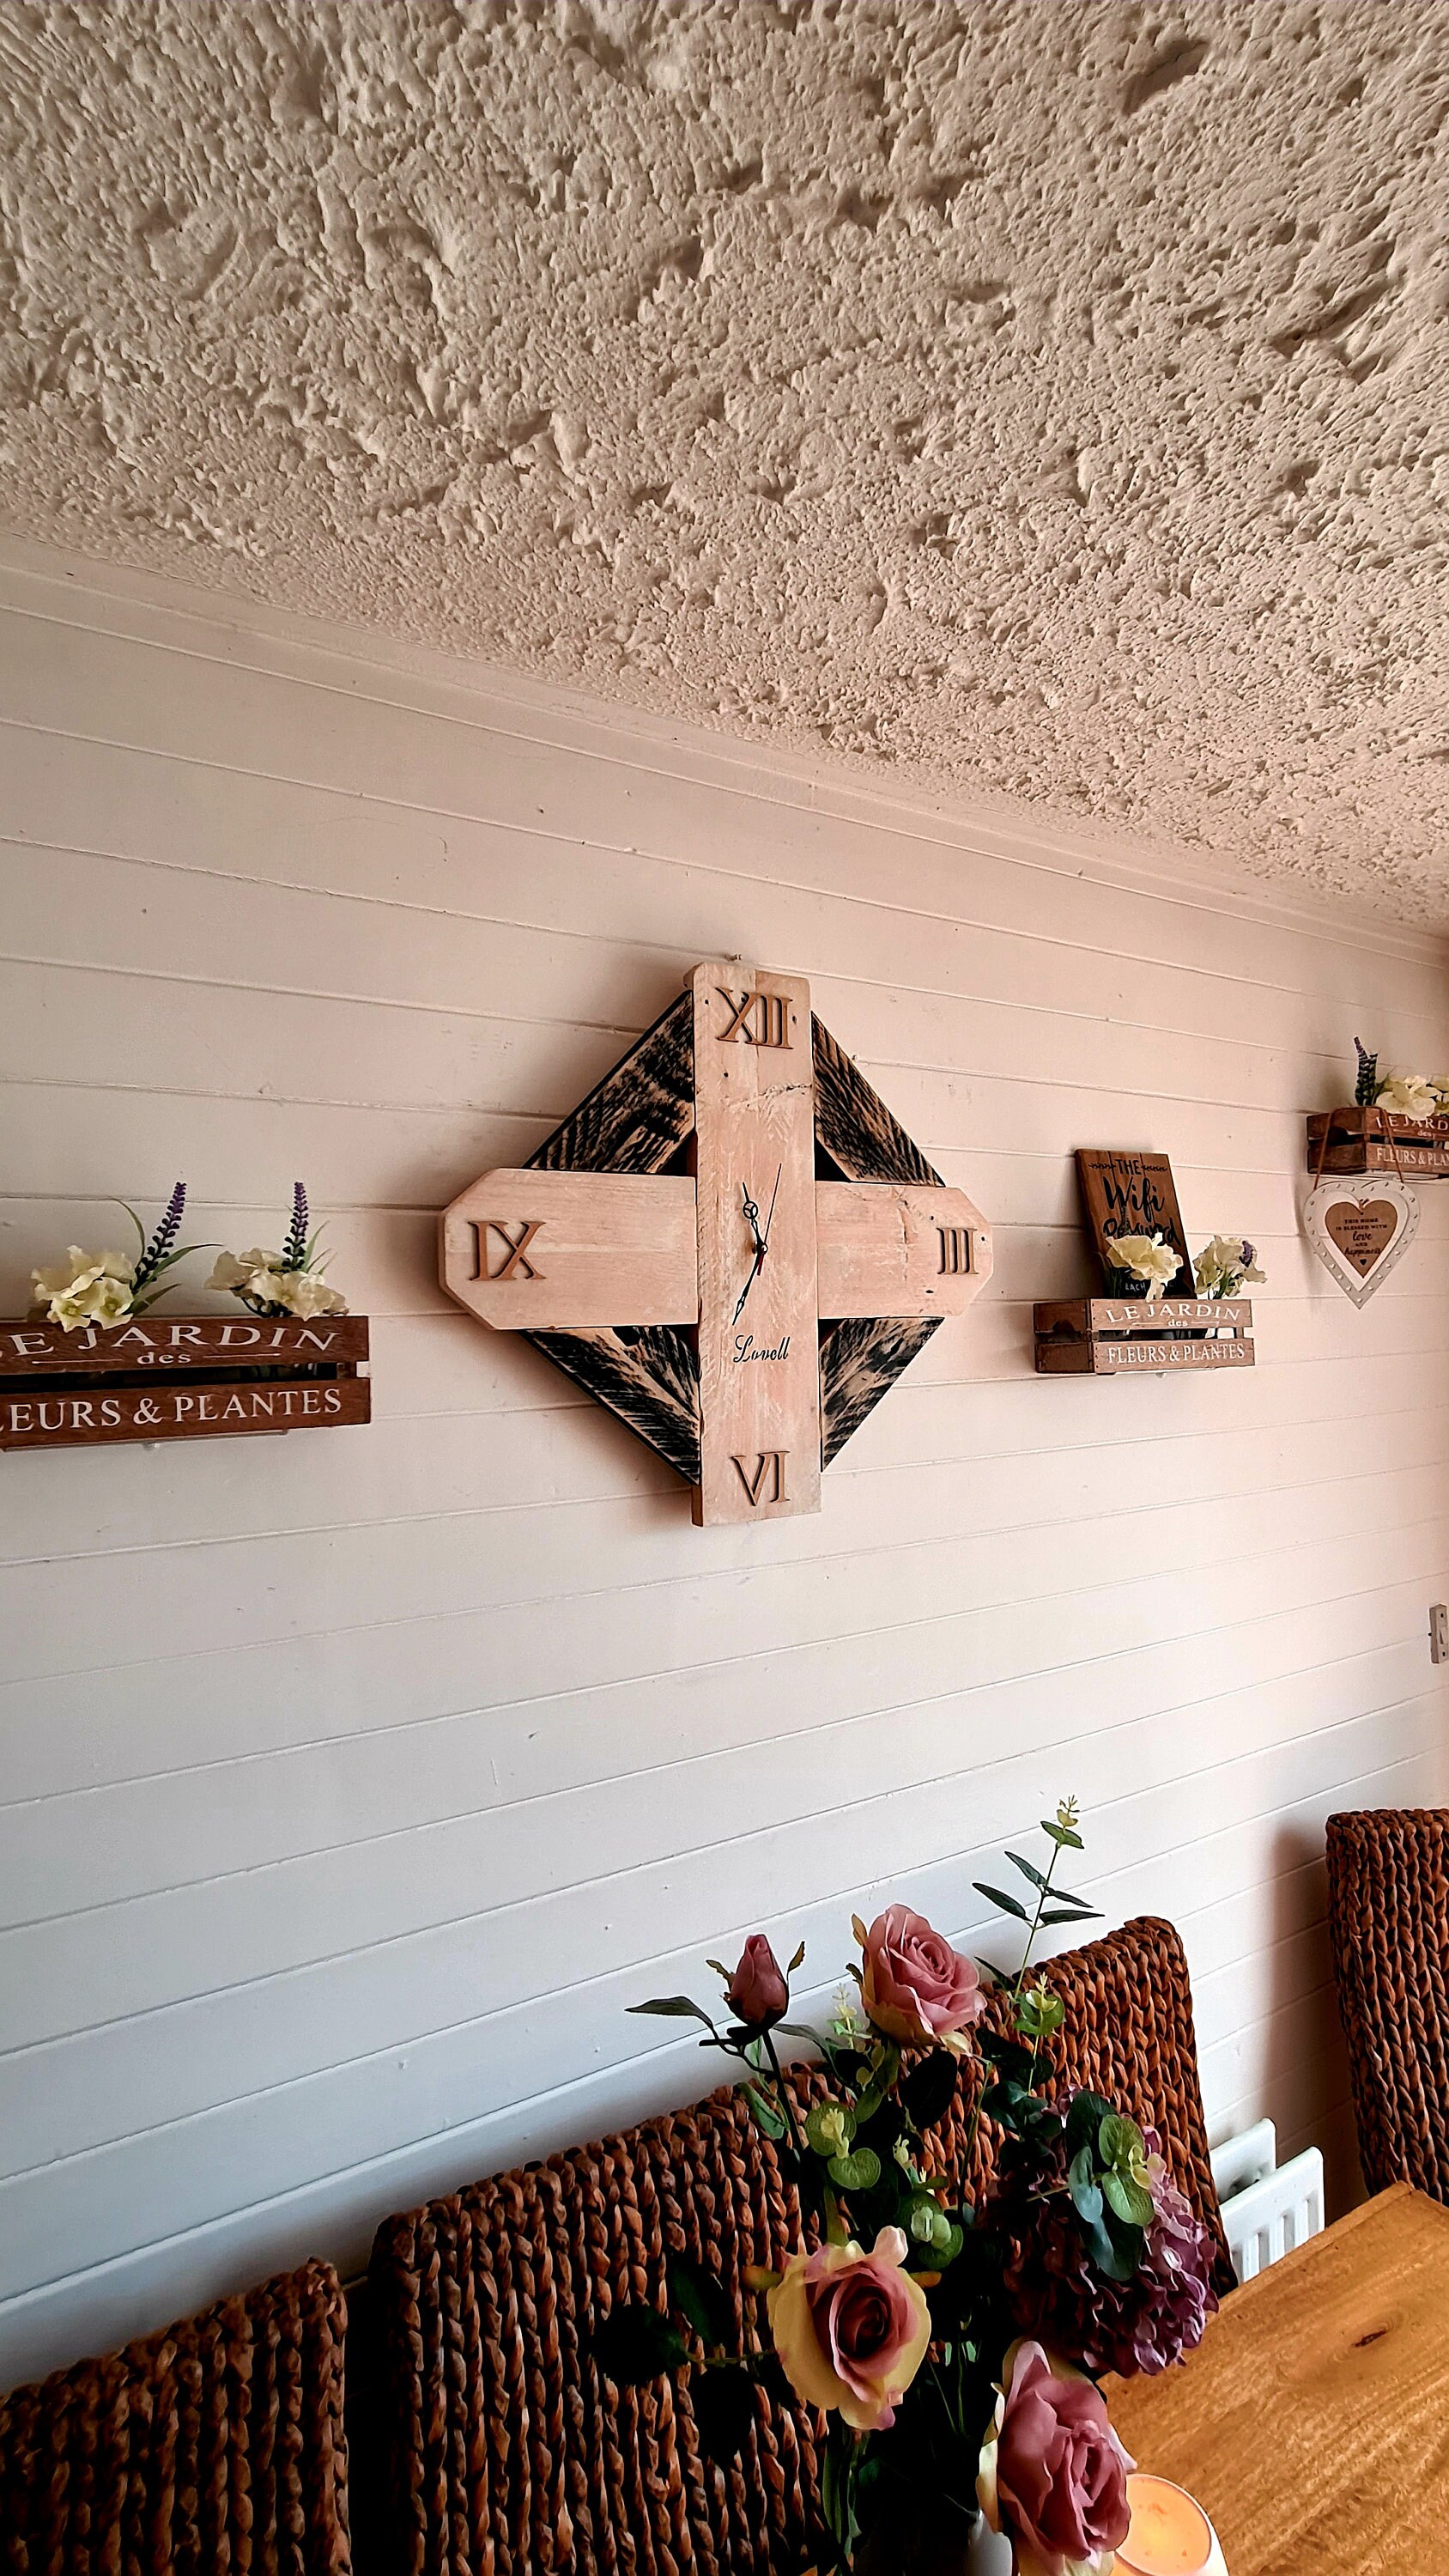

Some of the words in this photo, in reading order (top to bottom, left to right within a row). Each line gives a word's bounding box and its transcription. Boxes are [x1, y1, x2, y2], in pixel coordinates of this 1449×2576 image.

[715, 987, 793, 1049] XII
[1115, 1159, 1142, 1175] THE
[1418, 1151, 1426, 1164] &
[1103, 1176, 1165, 1223] Wifi
[468, 1220, 547, 1282] IX
[937, 1226, 979, 1275] III
[1106, 1305, 1140, 1323] LE
[1147, 1303, 1240, 1321] JARDIN
[0, 1333, 54, 1356] E
[77, 1325, 340, 1352] JARDIN
[733, 1334, 791, 1363] Lovell
[1108, 1346, 1166, 1364] FLEURS
[1169, 1345, 1180, 1362] &
[1184, 1343, 1245, 1361] PLANTES
[137, 1352, 191, 1364] des
[0, 1400, 122, 1432] EURS
[133, 1398, 165, 1425] &
[174, 1388, 342, 1423] PLANTES
[731, 1450, 791, 1507] VI
